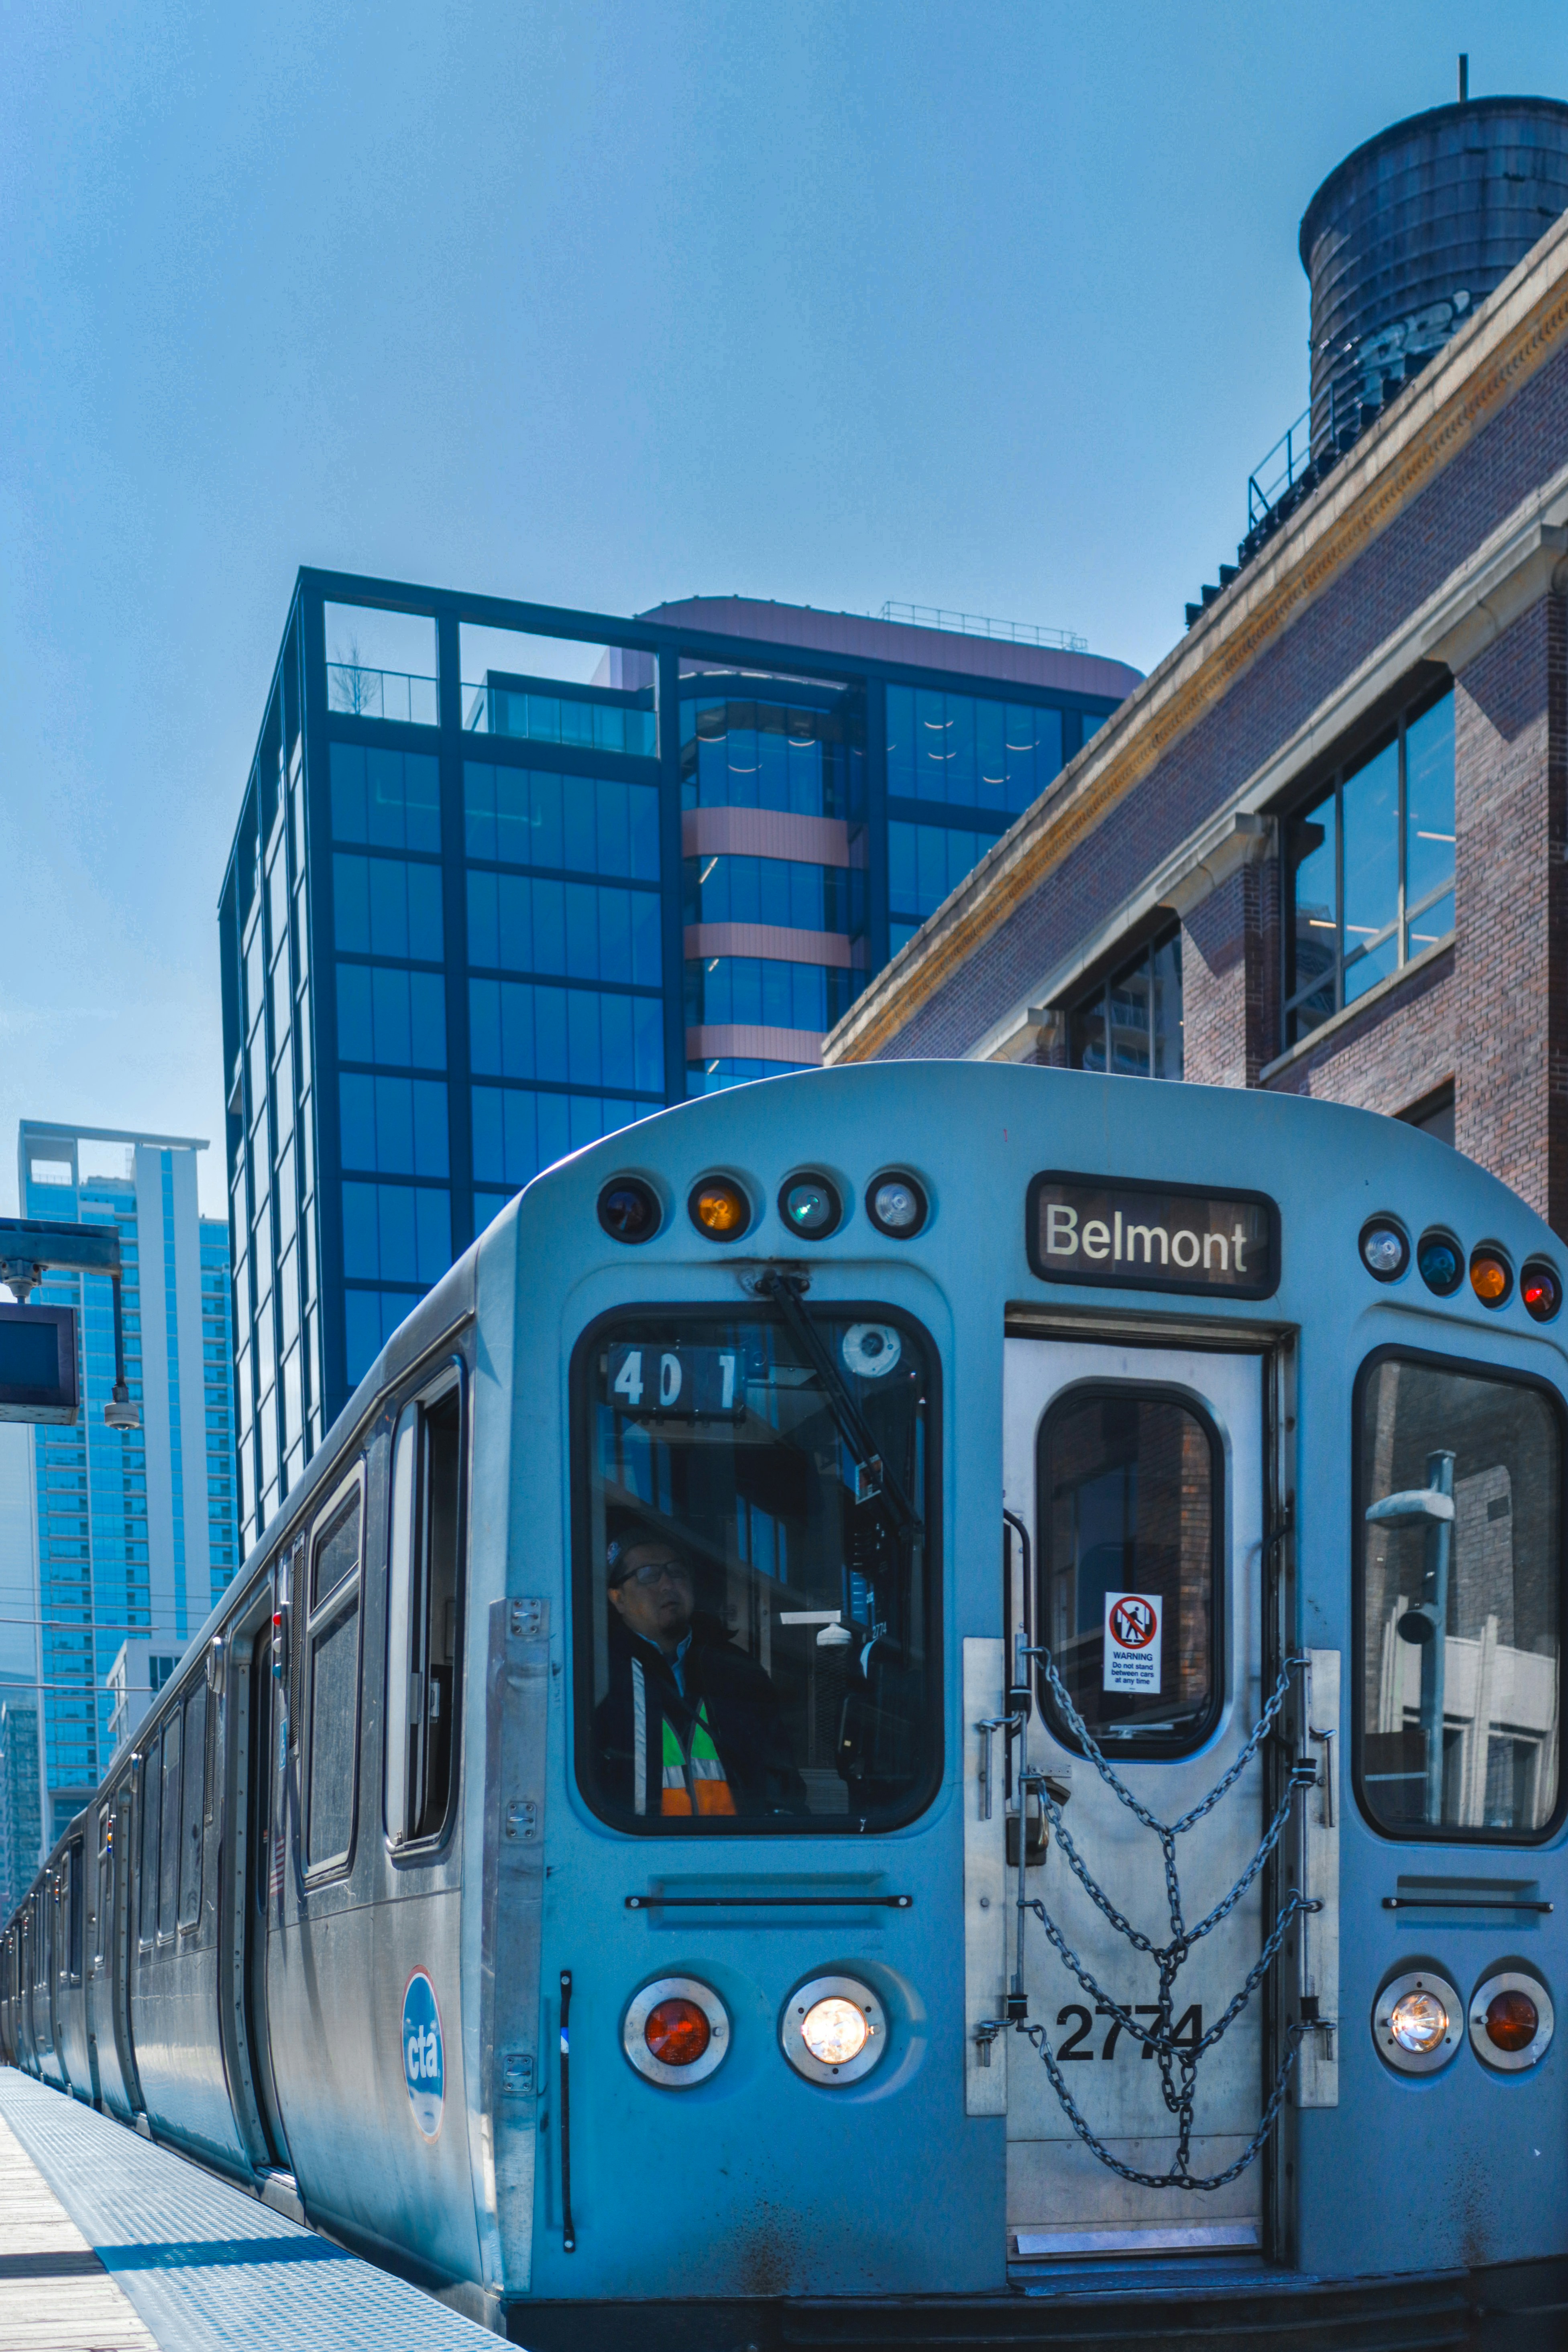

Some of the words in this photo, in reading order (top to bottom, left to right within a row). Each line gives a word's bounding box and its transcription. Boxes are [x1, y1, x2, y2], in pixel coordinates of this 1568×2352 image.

[1046, 1204, 1247, 1272] Belmont
[872, 1621, 887, 1639] 2774
[1113, 1651, 1153, 1660] WARNING
[408, 2024, 438, 2080] cta
[1057, 2004, 1206, 2061] 2774
